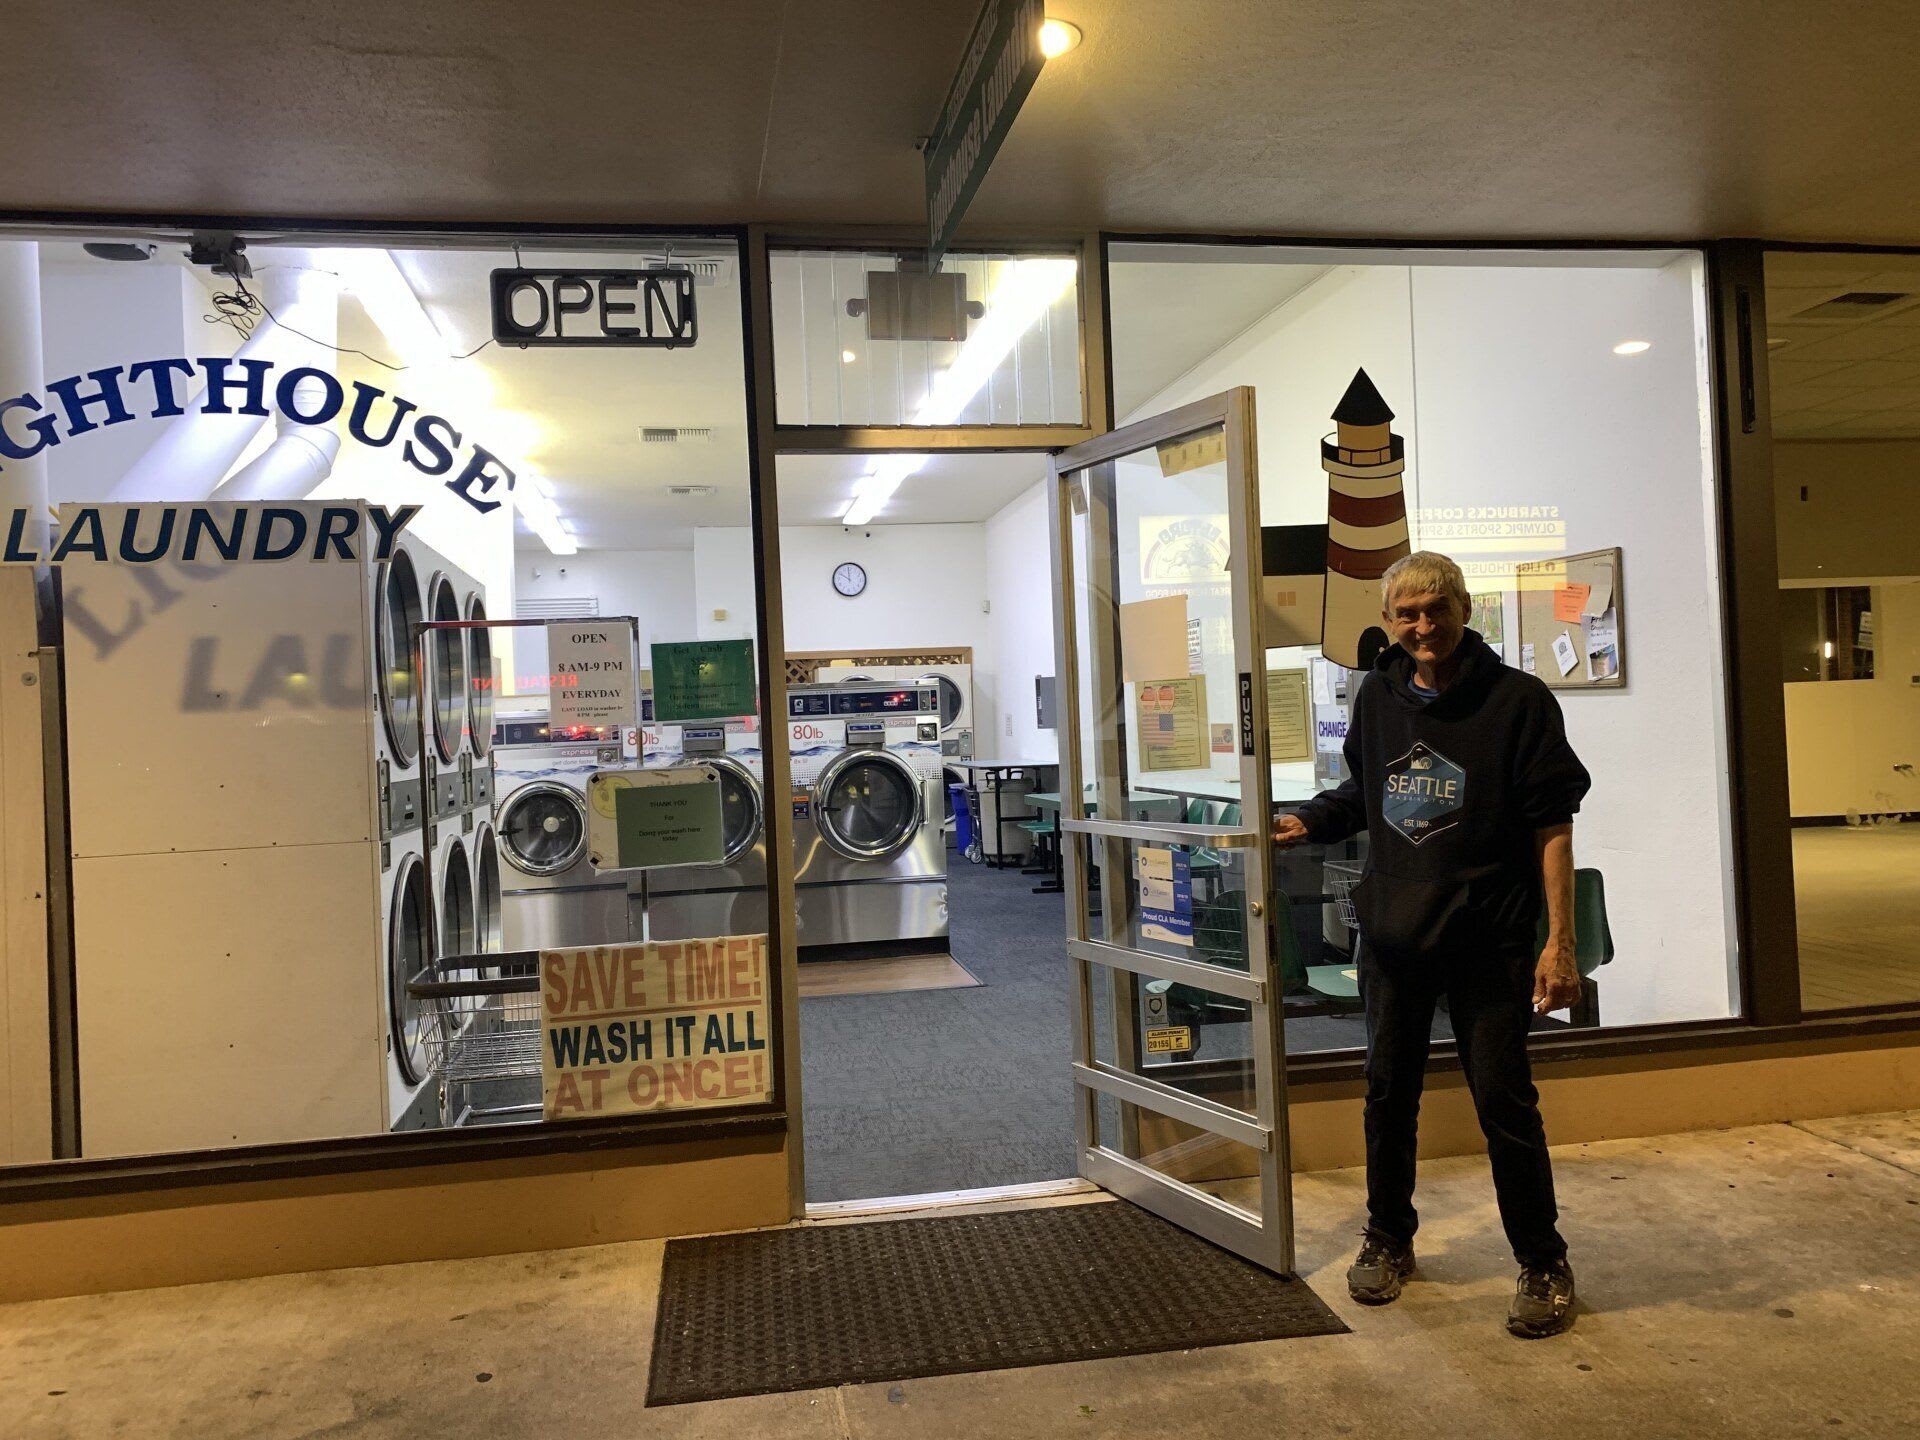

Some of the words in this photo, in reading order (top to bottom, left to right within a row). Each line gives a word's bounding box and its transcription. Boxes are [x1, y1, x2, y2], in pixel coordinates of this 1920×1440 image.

[505, 277, 686, 338] OPEN
[0, 357, 517, 514] GHTHOUSE
[3, 507, 418, 563] LAUNDRY
[571, 633, 608, 644] OPEN
[558, 662, 565, 673] 8
[567, 661, 600, 673] AM-9
[603, 660, 623, 671] PM
[562, 688, 621, 700] EVERYDAY
[1241, 680, 1254, 749] PUSH
[627, 730, 660, 746] 80lb
[793, 724, 824, 740] 80lb
[1318, 721, 1347, 739] CHANGE
[561, 748, 594, 758] express
[1387, 774, 1457, 799] SEATTLE
[650, 801, 673, 809] THANK
[673, 800, 688, 808] YOU
[1388, 795, 1454, 805] WASHINGTON
[1142, 911, 1158, 924] Proud
[1157, 914, 1169, 924] CLA
[1169, 914, 1191, 928] Member
[544, 947, 647, 1015] SAVE
[658, 938, 762, 1004] TIME!
[549, 1019, 653, 1069] WASH
[665, 1015, 696, 1058] IT
[703, 1010, 766, 1055] ALL
[553, 1069, 611, 1114] AT
[627, 1054, 764, 1107] ONCE!
